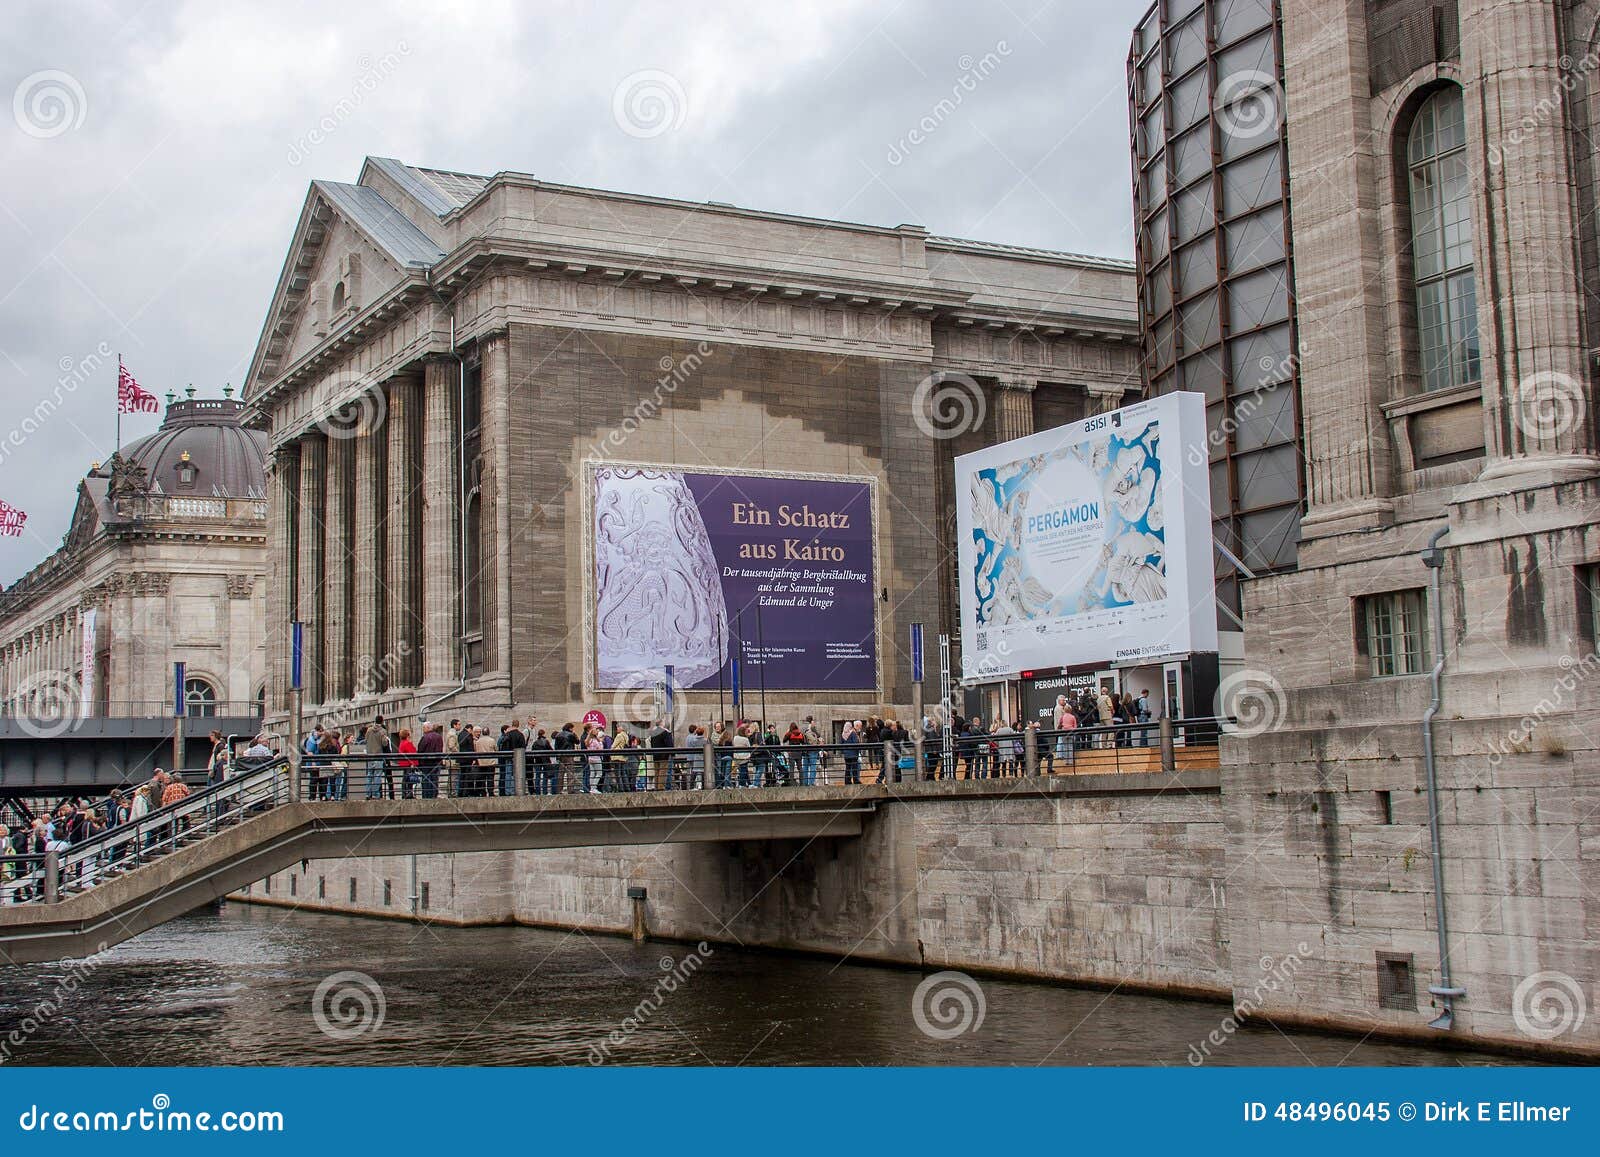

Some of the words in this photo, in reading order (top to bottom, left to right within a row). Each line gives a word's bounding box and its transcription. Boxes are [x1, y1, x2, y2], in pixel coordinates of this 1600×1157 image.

[732, 502, 771, 526] Ein
[778, 505, 850, 529] Schatz
[1028, 501, 1099, 534] PERGAMON
[740, 543, 776, 559] aus
[784, 539, 845, 561] Kairo
[723, 567, 740, 577] Der
[741, 568, 801, 581] tausendjährige
[803, 569, 867, 584] Bergkristallkrug
[757, 584, 772, 592] aus
[774, 583, 788, 592] der
[790, 583, 835, 596] Sammlung
[760, 596, 796, 606] Edmund
[797, 597, 807, 607] de
[809, 597, 834, 609] Unger
